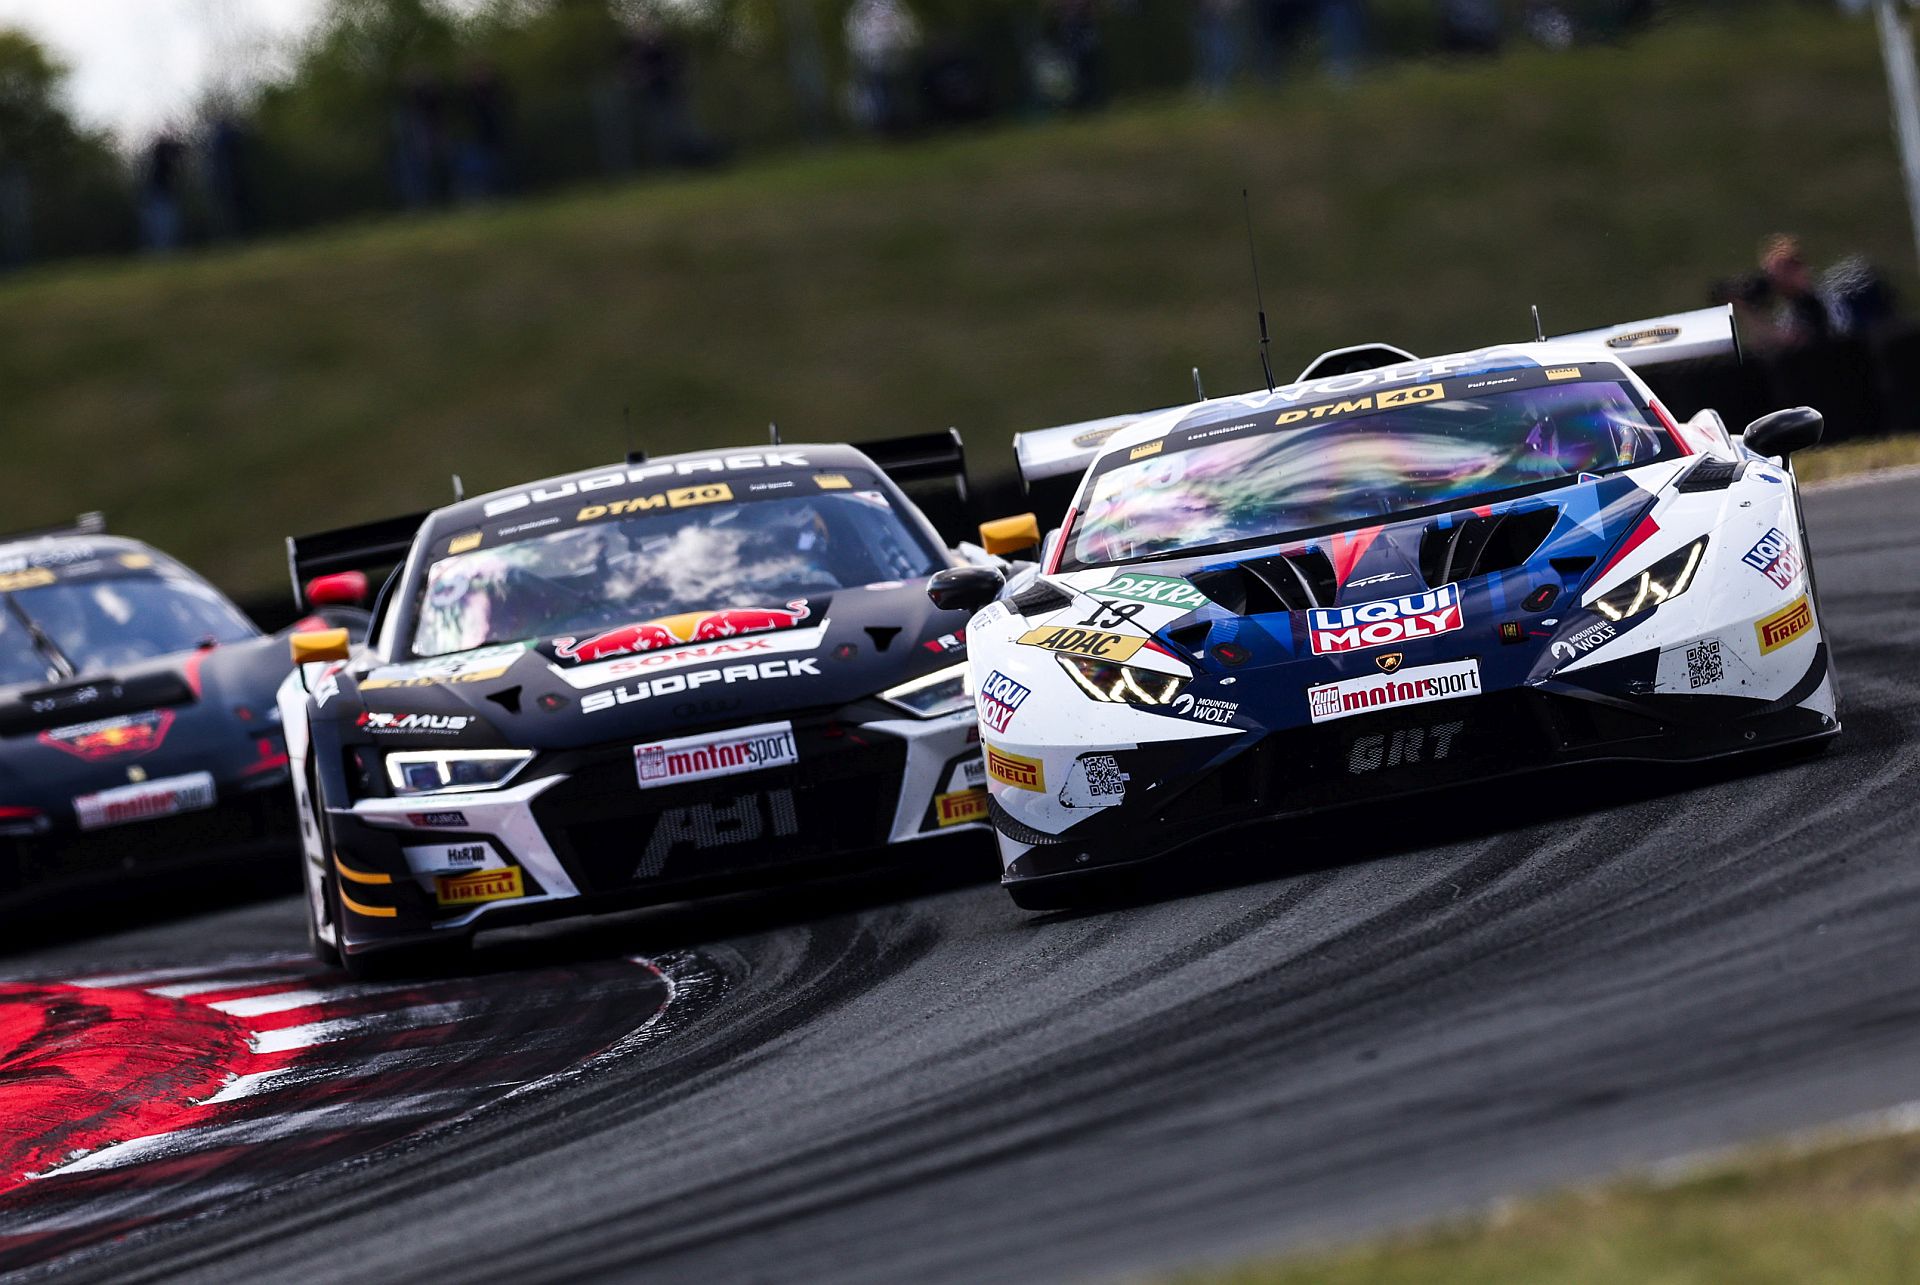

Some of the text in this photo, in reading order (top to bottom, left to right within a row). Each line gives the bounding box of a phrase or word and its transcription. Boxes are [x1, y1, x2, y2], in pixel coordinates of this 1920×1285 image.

[1275, 387, 1436, 426] DTM 40
[576, 493, 667, 522] DTM
[1744, 529, 1789, 570] LIQUI
[1095, 577, 1207, 607] DEKRA
[1077, 600, 1145, 629] 19
[1316, 587, 1451, 629] LIQUI
[1319, 605, 1457, 650] MOLY
[1568, 620, 1608, 644] MOUNTAIN
[1574, 625, 1617, 652] WOLF
[1761, 602, 1811, 647] PIRELLI
[609, 638, 775, 674] SONAX
[1041, 628, 1122, 656] ADAC
[982, 671, 1029, 709] LIQUI
[1197, 697, 1239, 711] MOUNTAIN
[1312, 687, 1338, 705] Auto
[1342, 669, 1479, 711] motorsport
[980, 694, 1014, 732] MOLY
[1193, 705, 1236, 724] WOLF
[1314, 701, 1340, 716] Bild
[667, 731, 795, 777] motorsport
[988, 750, 1037, 786] PIRELLI
[941, 792, 986, 819] PIRE
[440, 871, 516, 900] PIRELLI
